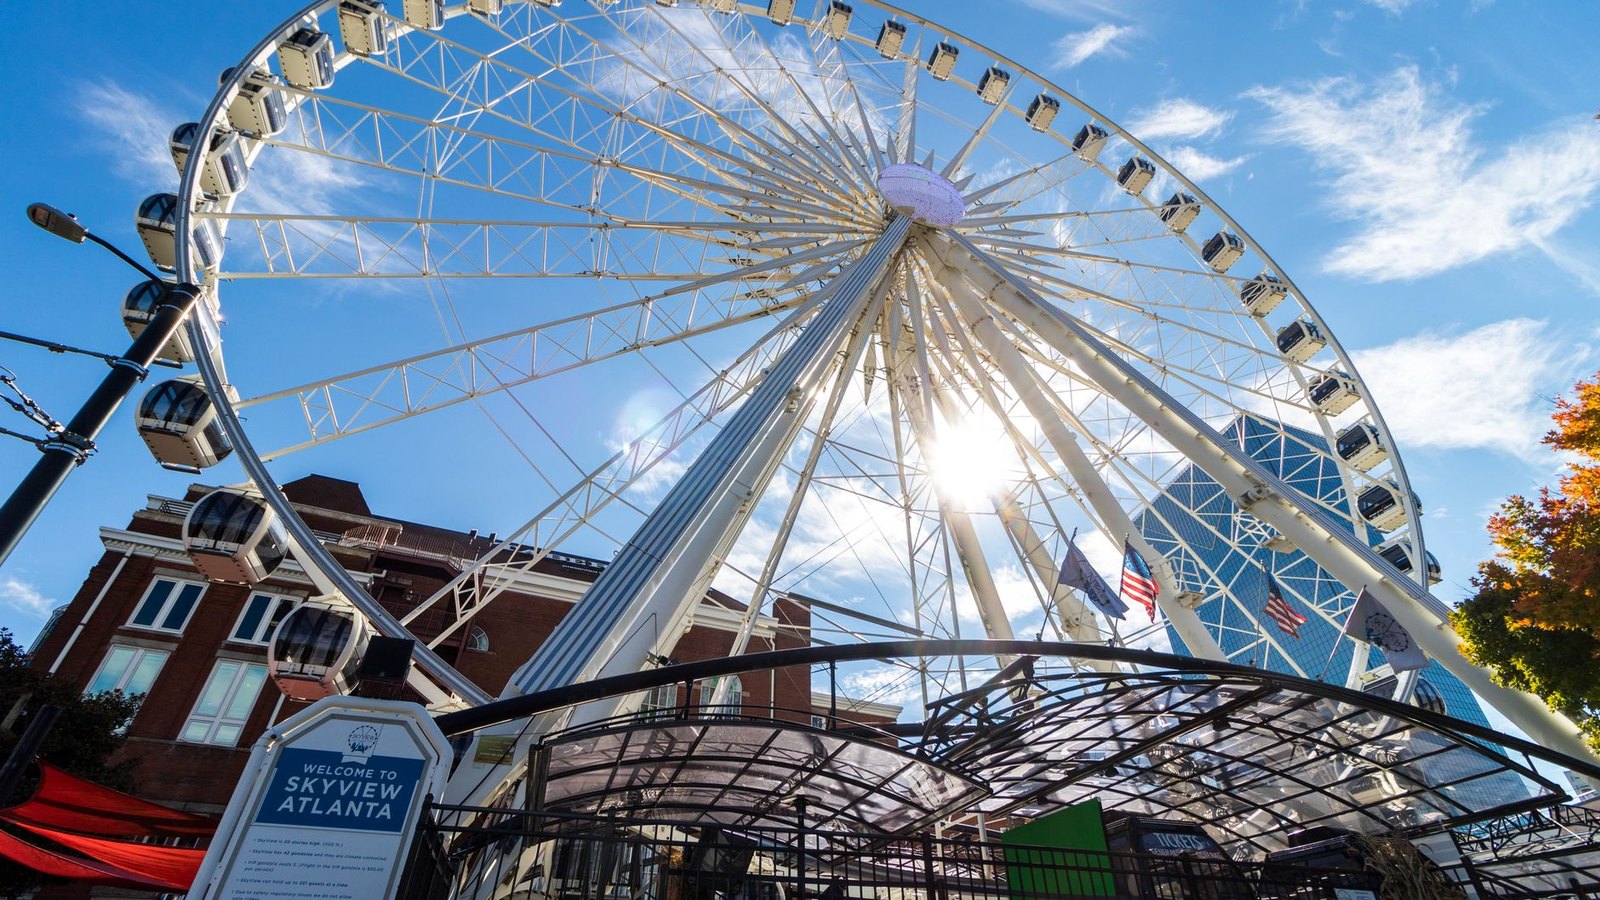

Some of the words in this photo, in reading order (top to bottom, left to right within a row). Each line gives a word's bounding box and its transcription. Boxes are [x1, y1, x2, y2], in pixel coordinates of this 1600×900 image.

[303, 763, 375, 779] WELCOME
[379, 770, 397, 781] TO
[284, 776, 403, 800] SKYVIEW
[277, 797, 392, 820] ATLANTA
[1153, 832, 1203, 850] TICKETS
